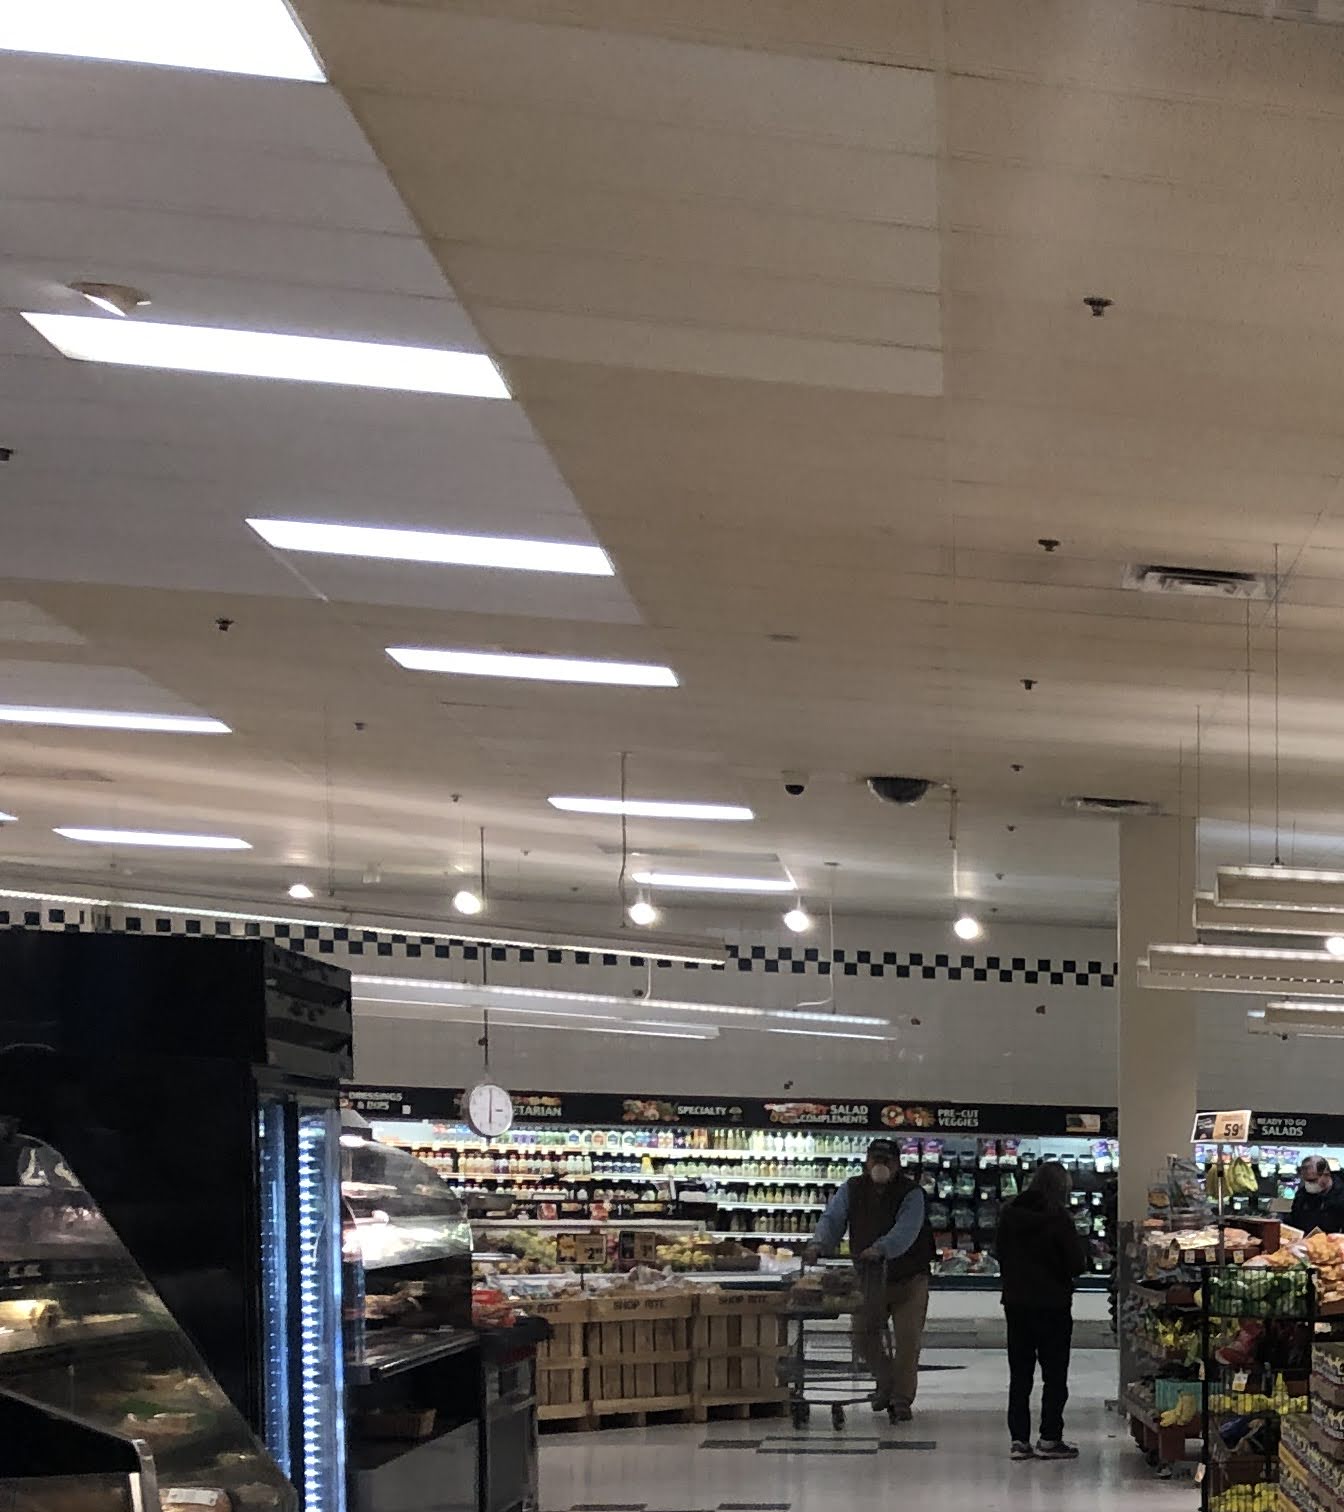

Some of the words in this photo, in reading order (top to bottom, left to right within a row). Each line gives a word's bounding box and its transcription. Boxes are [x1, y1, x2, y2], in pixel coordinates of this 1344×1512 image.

[513, 1104, 562, 1117] ETARIAN
[677, 1105, 728, 1116] SPECIALTY
[829, 1104, 869, 1115] SALAD
[937, 1109, 979, 1118] PRE-CUT
[800, 1113, 869, 1124] COMPLEMENTS
[938, 1117, 979, 1127] VEGGIES
[1257, 1117, 1281, 1125] READY
[1283, 1118, 1294, 1126] TO
[1295, 1118, 1307, 1126] GO
[1261, 1125, 1304, 1136] SALADS
